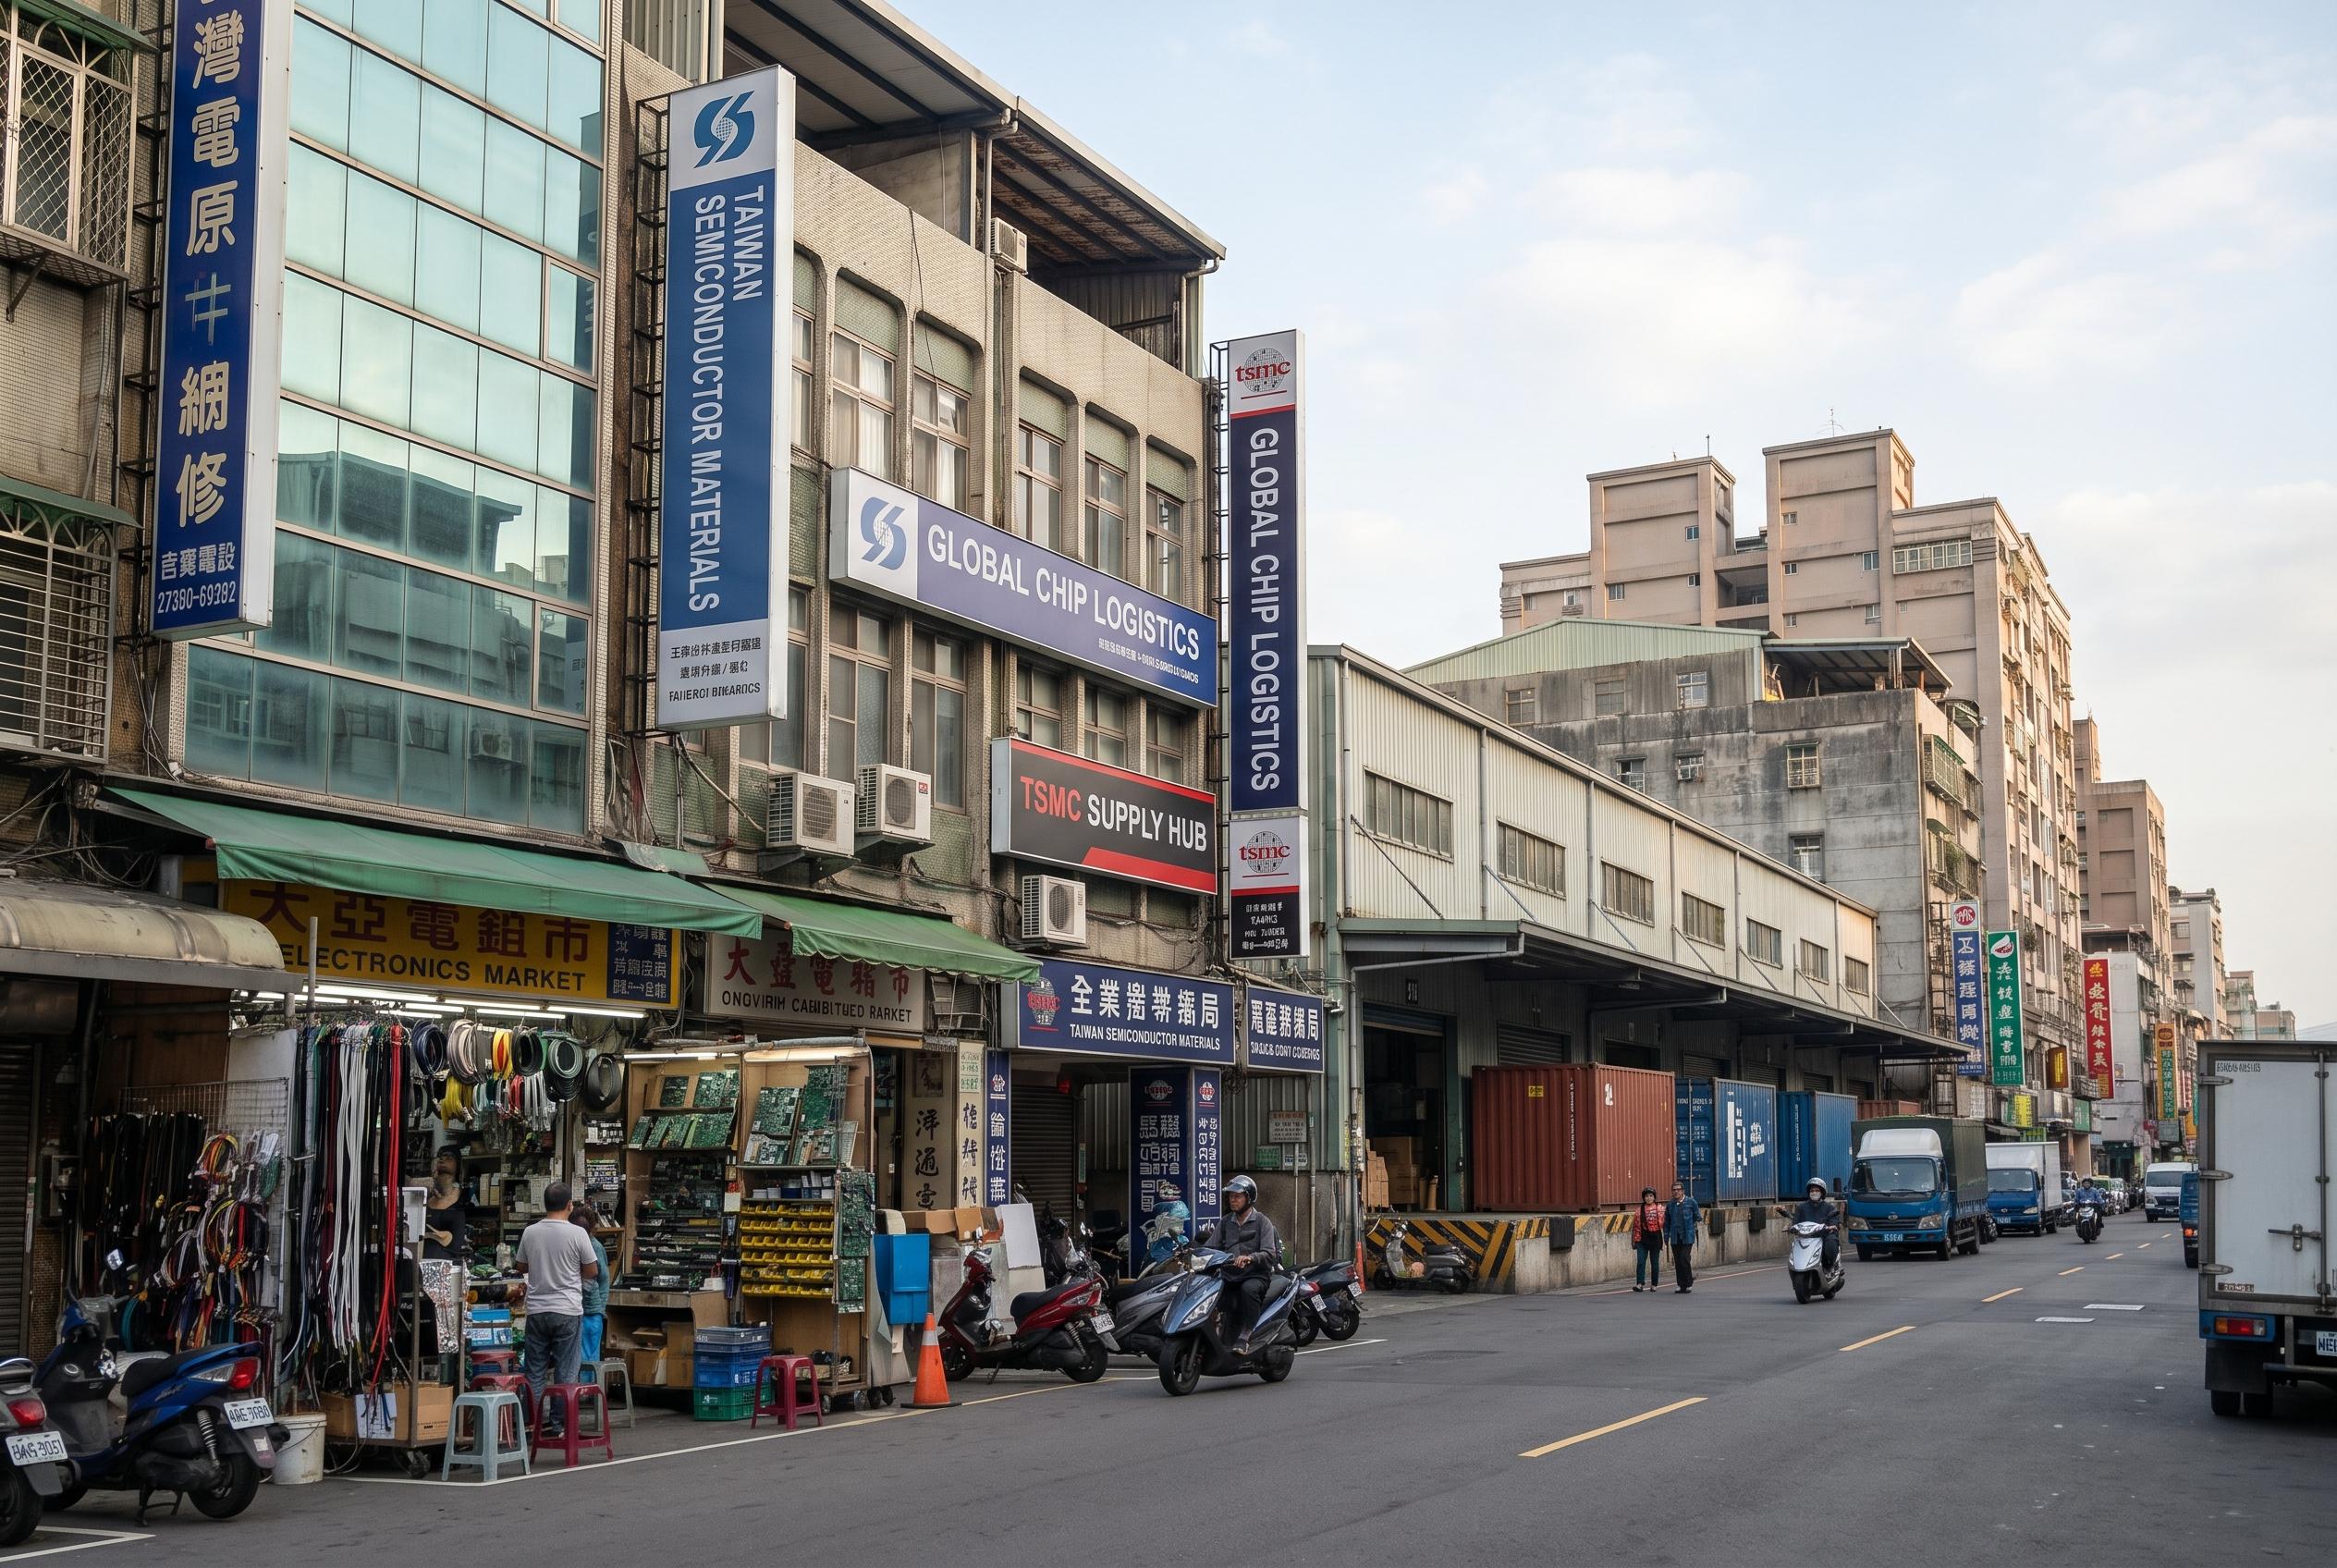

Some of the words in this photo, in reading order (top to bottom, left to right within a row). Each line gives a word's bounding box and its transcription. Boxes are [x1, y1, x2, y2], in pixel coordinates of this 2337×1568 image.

[732, 185, 765, 301] TAIWAN
[691, 194, 727, 445] SEMICONDUCTOR
[1235, 360, 1291, 383] tsmc
[688, 449, 723, 612] MATERIALS
[1250, 427, 1279, 548] GLOBAL
[927, 523, 1029, 596] GLOBAL
[1035, 568, 1088, 615] CHIP
[1094, 589, 1200, 661] LOGISTICS
[1250, 554, 1279, 623] CHIP
[1250, 631, 1280, 791] LOGISTICS
[1020, 775, 1082, 822] TSMC
[1087, 793, 1164, 841] SUPPLY
[1168, 814, 1207, 851] HUB
[1239, 845, 1291, 861] tsmc
[280, 943, 471, 982] ELECTRONICS
[485, 963, 586, 992] MARKET
[1070, 1023, 1104, 1041] TAIWAN
[1106, 1027, 1178, 1047] SEMICONDUCTOR
[1179, 1034, 1220, 1051] MATERIALS
